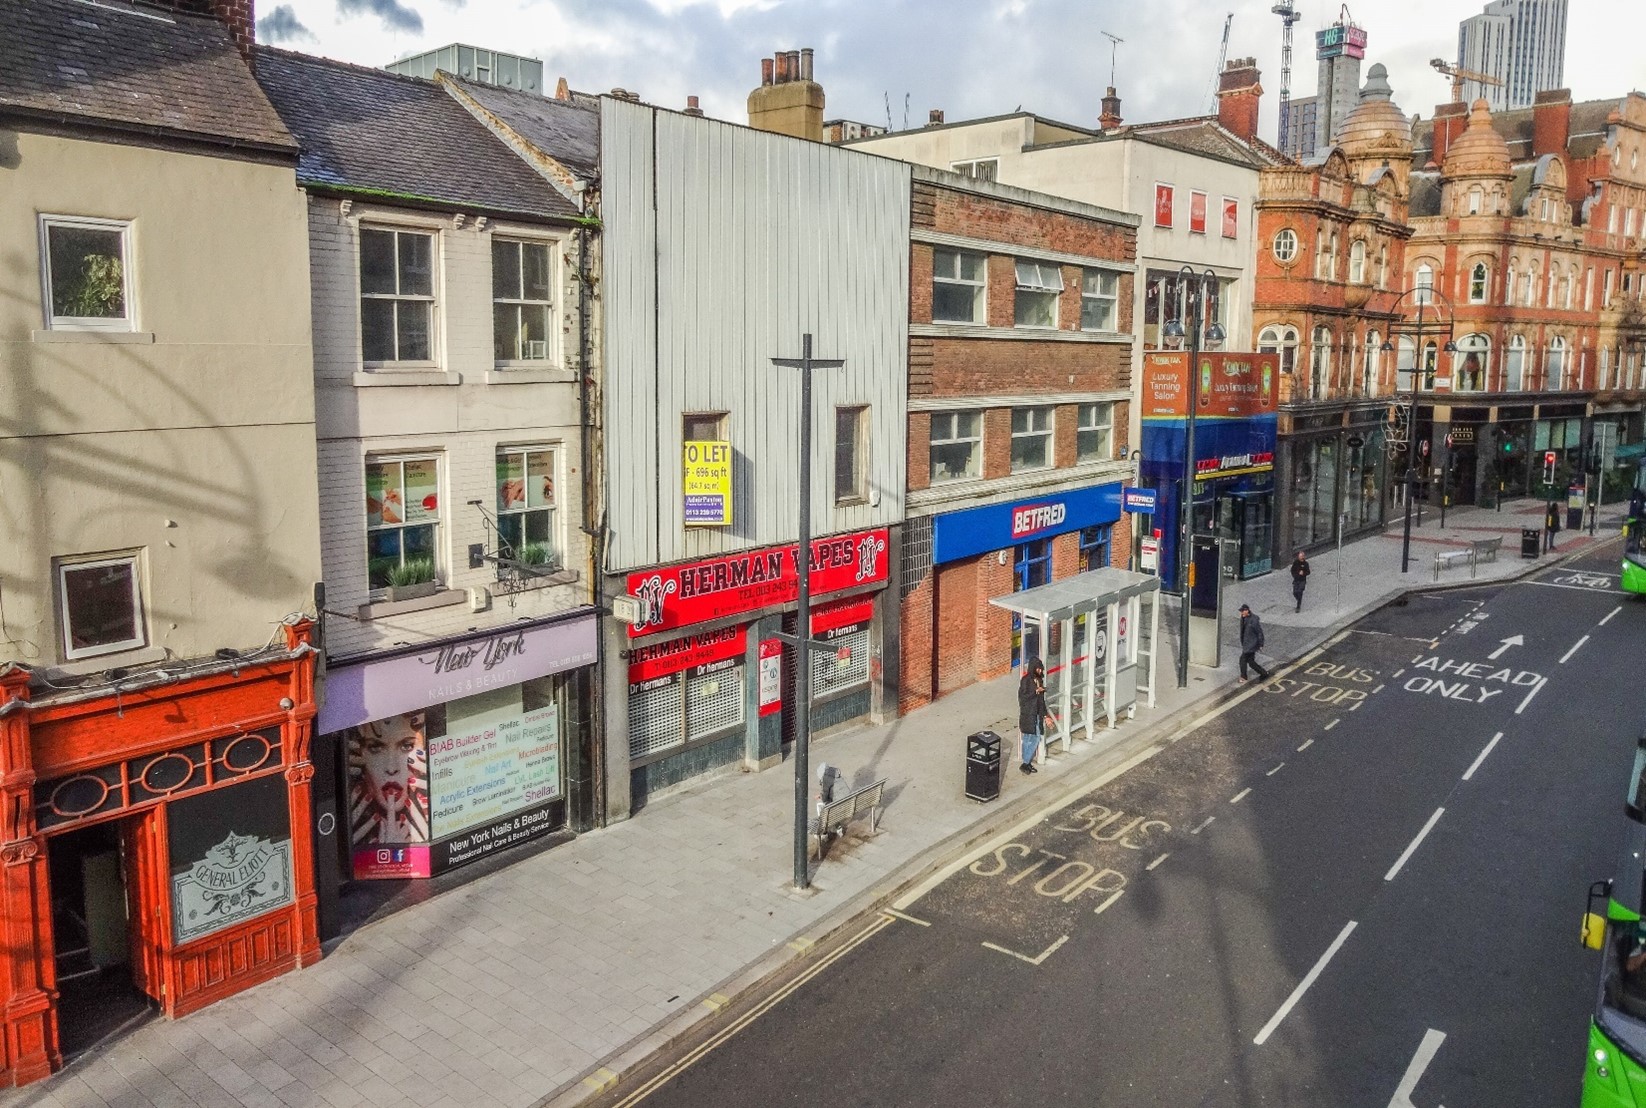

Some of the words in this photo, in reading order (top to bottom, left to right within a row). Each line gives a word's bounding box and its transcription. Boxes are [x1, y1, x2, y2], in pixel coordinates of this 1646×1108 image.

[1150, 382, 1181, 392] Tanning
[1152, 372, 1179, 383] Luxury
[1154, 391, 1175, 400] Salon
[685, 445, 698, 463] O
[704, 445, 728, 463] LET
[696, 467, 709, 478] 696
[711, 469, 719, 480] sq
[721, 467, 727, 478] ft
[1013, 503, 1066, 534] BETFRED
[679, 553, 782, 599] HERMAN
[418, 638, 488, 674] New
[483, 630, 526, 671] York
[628, 636, 692, 665] HERMAN
[695, 625, 736, 648] VAPES
[697, 665, 706, 676] Dr
[706, 658, 735, 672] hermans
[1304, 661, 1375, 683] BUS
[1423, 655, 1543, 687] AHEAD
[428, 684, 463, 700] NAILS
[466, 679, 472, 690] &
[477, 668, 518, 688] BEAUTY
[630, 684, 639, 694] Dr
[640, 675, 672, 691] hermans
[1264, 678, 1368, 705] STOP
[1403, 676, 1504, 704] ONLY
[499, 720, 520, 732] Shellac
[505, 731, 520, 744] Nail
[522, 723, 552, 739] Repairs
[429, 739, 454, 756] BIAB
[456, 734, 481, 748] Builder
[484, 728, 497, 740] Gel
[518, 742, 558, 761] Microblading
[433, 752, 459, 767] Eyebrow
[501, 759, 512, 770] Art
[432, 768, 453, 780] Infills
[528, 769, 544, 781] Lash
[440, 790, 465, 805] Acrylic
[466, 778, 507, 796] Extensions
[525, 785, 556, 803] Shellac
[433, 804, 464, 820] Pedicure
[449, 840, 469, 854] New
[471, 830, 490, 845] York
[491, 822, 512, 838] Nails
[513, 818, 520, 829] &
[521, 809, 549, 827] Beauty
[1053, 804, 1172, 849] BUS
[449, 845, 482, 865] Professional
[482, 844, 493, 853] Nail
[494, 838, 507, 848] Care
[512, 829, 530, 841] Beauty
[531, 822, 550, 834] Service
[195, 864, 238, 889] GENERAL
[238, 846, 269, 881] ELIOTT
[968, 843, 1128, 903] STOP
